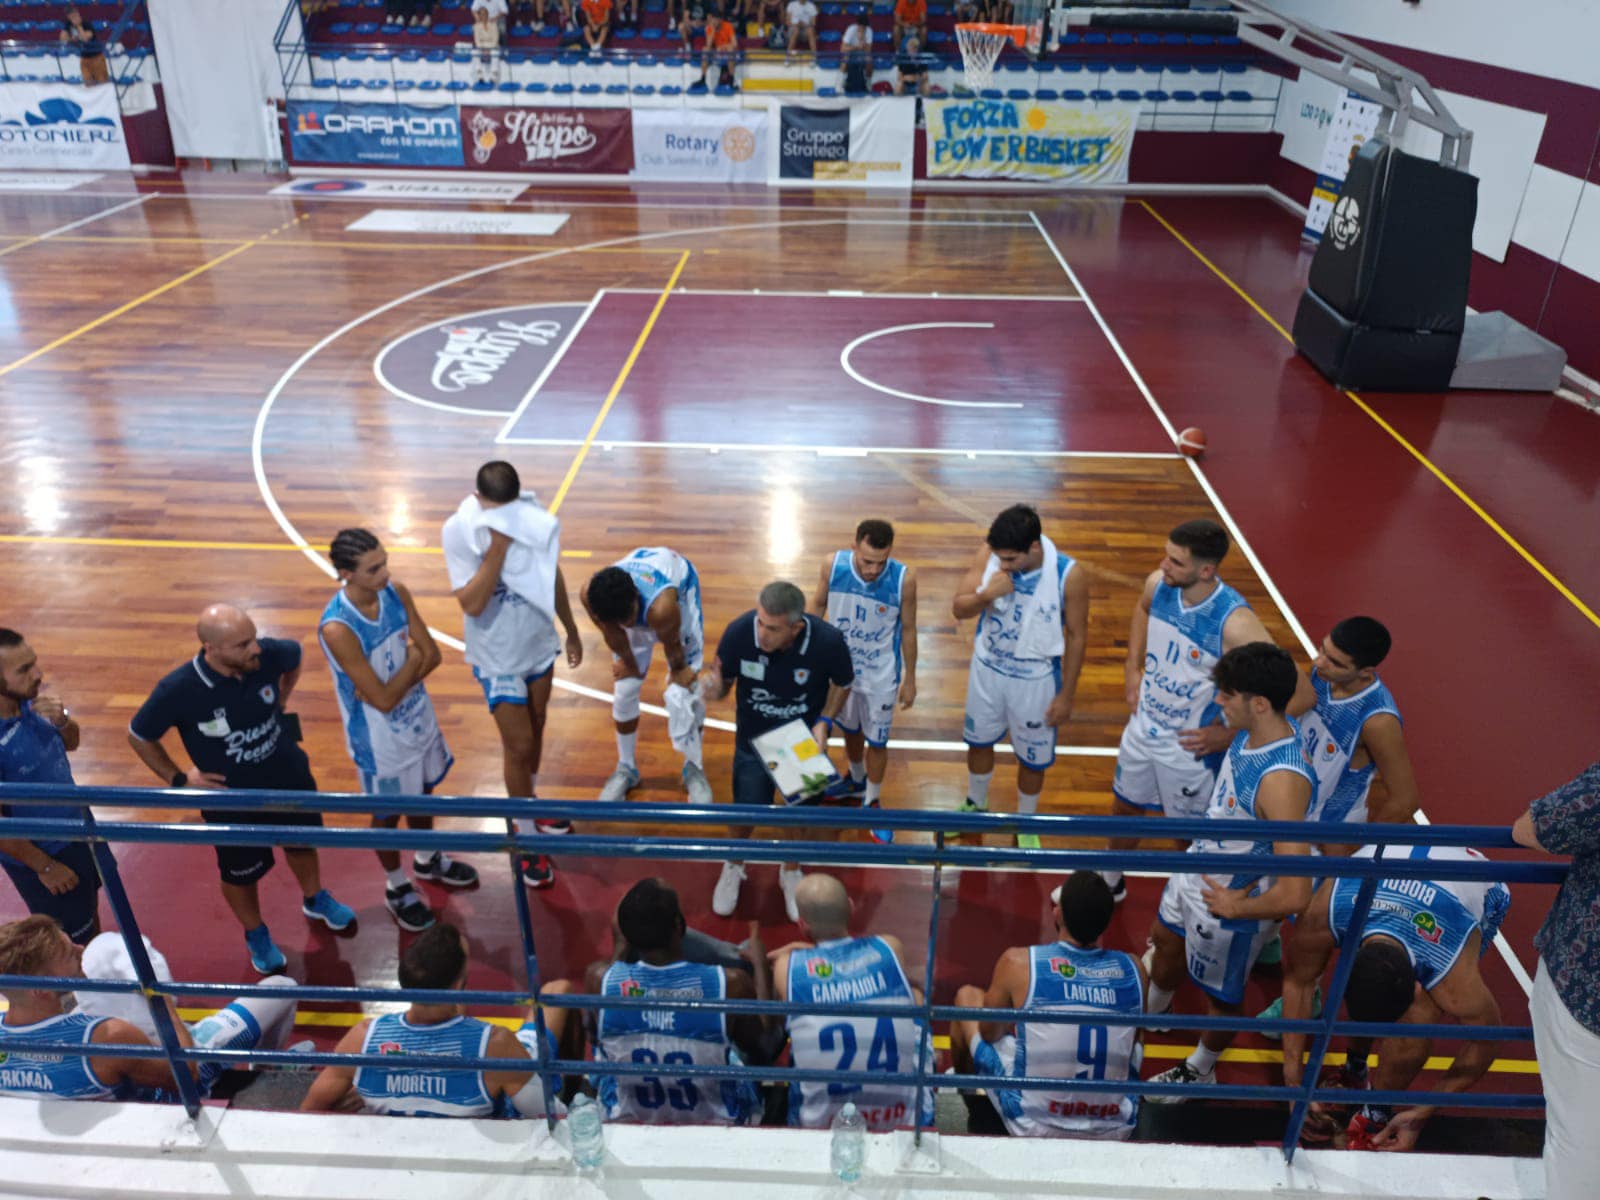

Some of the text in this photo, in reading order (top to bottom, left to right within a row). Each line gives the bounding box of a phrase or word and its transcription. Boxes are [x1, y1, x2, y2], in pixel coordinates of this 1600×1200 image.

[942, 100, 1019, 138] FORZA
[504, 110, 596, 161] Hippo
[665, 134, 719, 154] Rotary
[787, 128, 845, 143] Gruppo
[783, 143, 845, 158] Stratego
[1026, 747, 1037, 762] 5
[812, 970, 887, 1004] CAMPAIOLA
[1063, 981, 1117, 1006] LAUTARO
[819, 1016, 899, 1097] 24
[1075, 1023, 1108, 1082] 9
[386, 1073, 447, 1097] MORETTI
